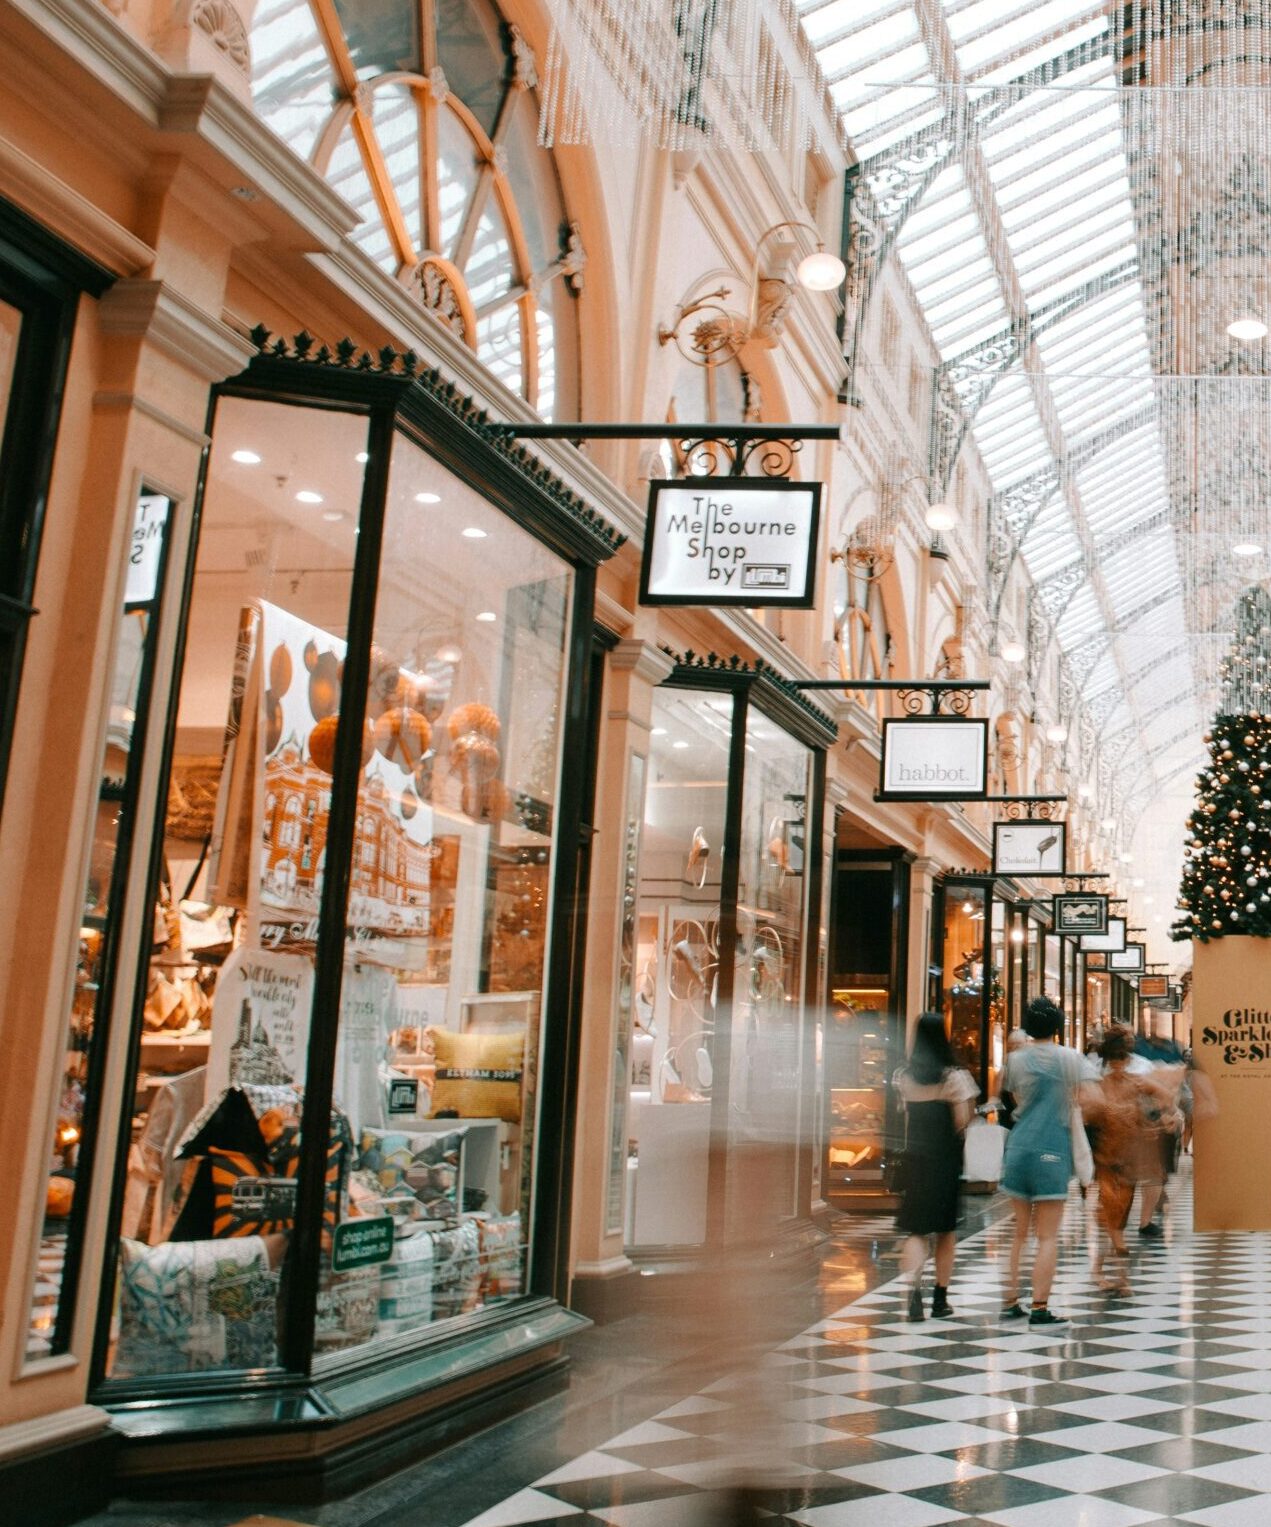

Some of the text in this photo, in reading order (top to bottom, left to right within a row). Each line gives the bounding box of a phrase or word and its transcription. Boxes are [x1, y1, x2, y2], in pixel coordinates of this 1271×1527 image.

[693, 497, 733, 516] The
[667, 514, 797, 536] Melbourne
[687, 537, 747, 564] Shop
[708, 566, 737, 586] by
